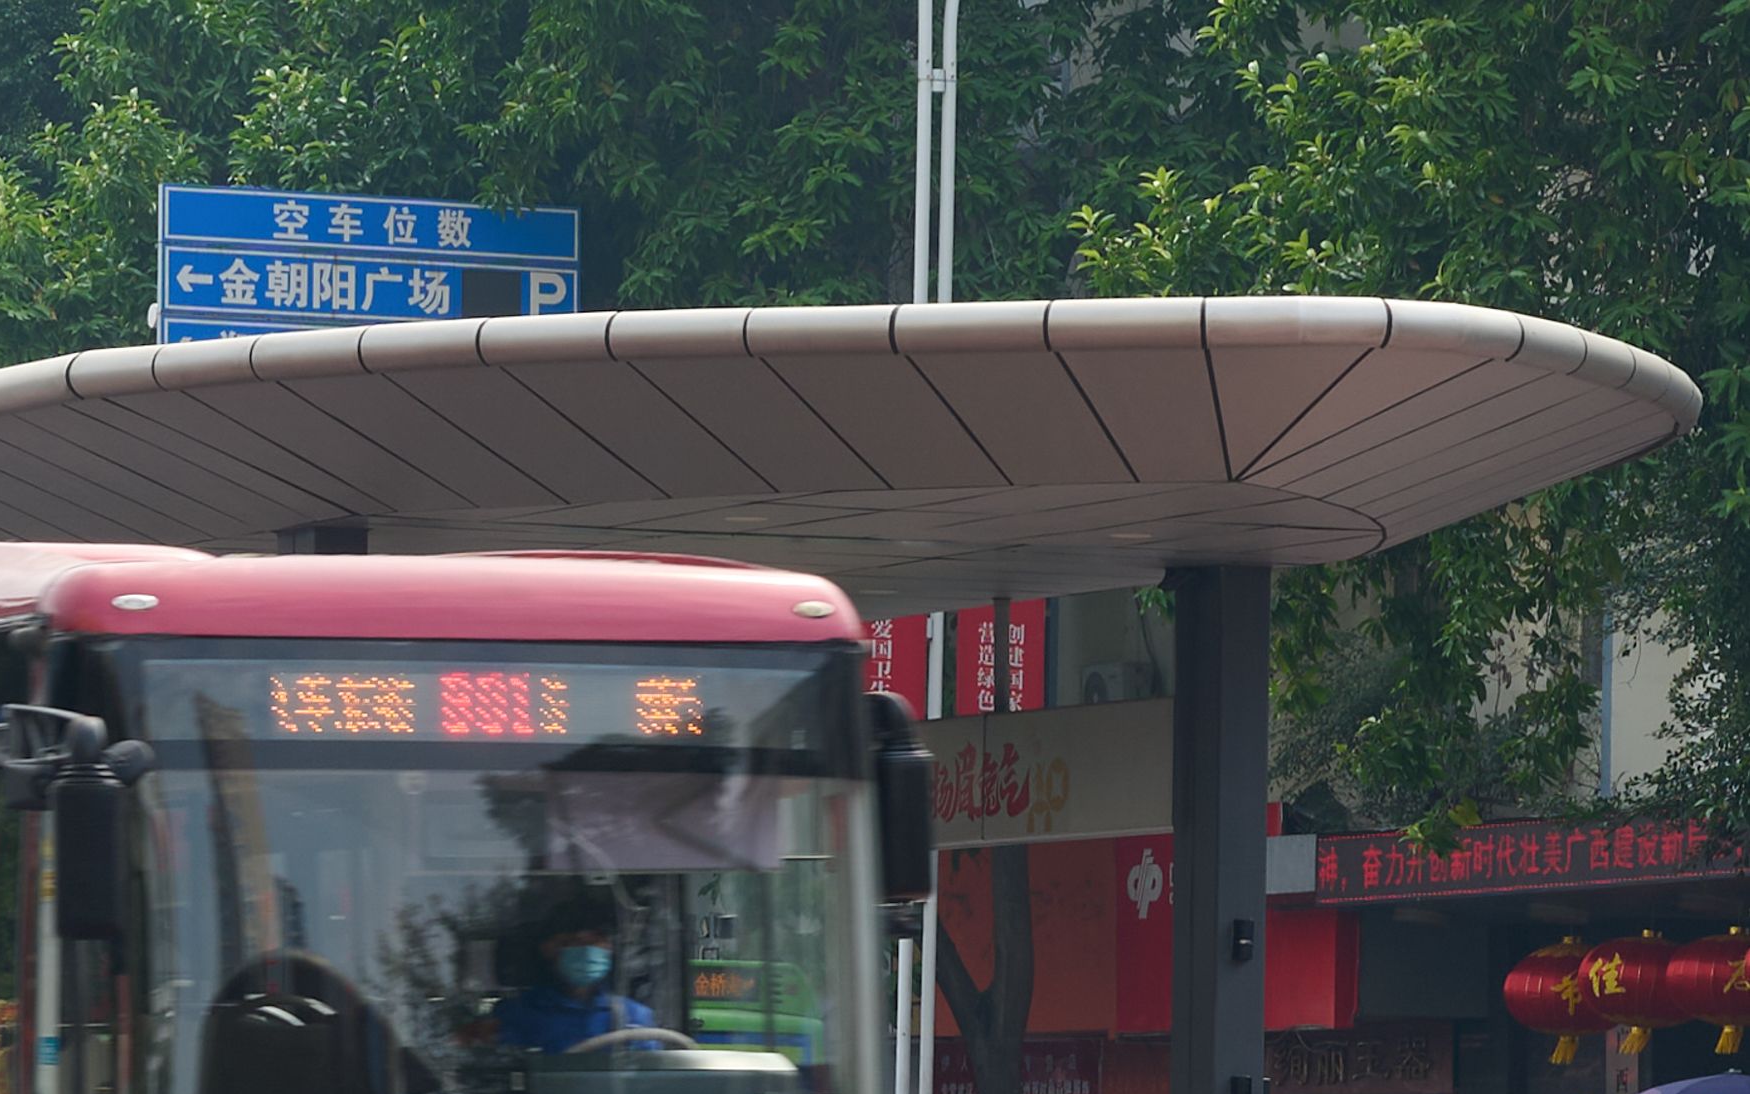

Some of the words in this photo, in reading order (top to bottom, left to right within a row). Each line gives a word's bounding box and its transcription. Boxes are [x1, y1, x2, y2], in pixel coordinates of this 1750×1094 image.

[273, 201, 472, 249] 空车位数
[219, 257, 451, 316] 金朝阳广场
[530, 272, 567, 315] P
